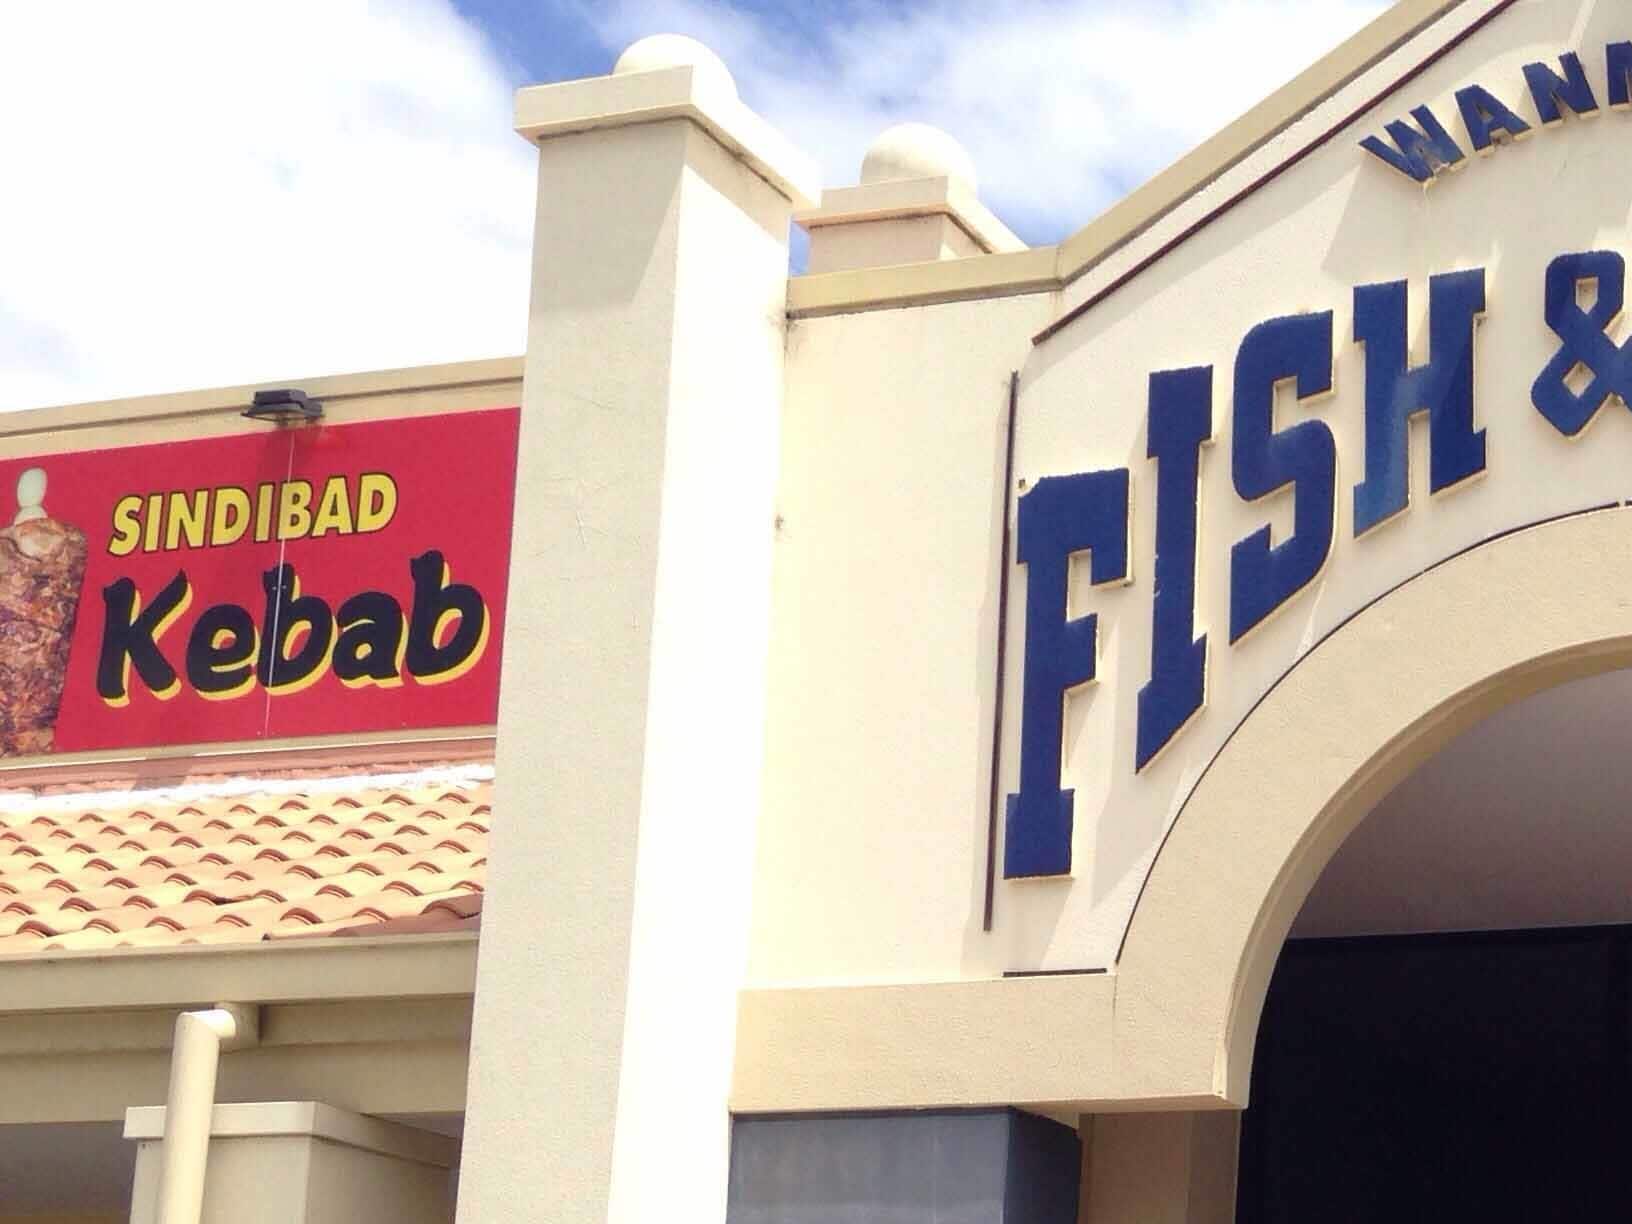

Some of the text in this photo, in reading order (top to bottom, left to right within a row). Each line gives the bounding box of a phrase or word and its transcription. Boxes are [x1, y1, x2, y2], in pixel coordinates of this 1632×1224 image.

[107, 472, 398, 556] SINDIBAD
[1003, 267, 1487, 880] FISH
[96, 550, 490, 709] Kebab
